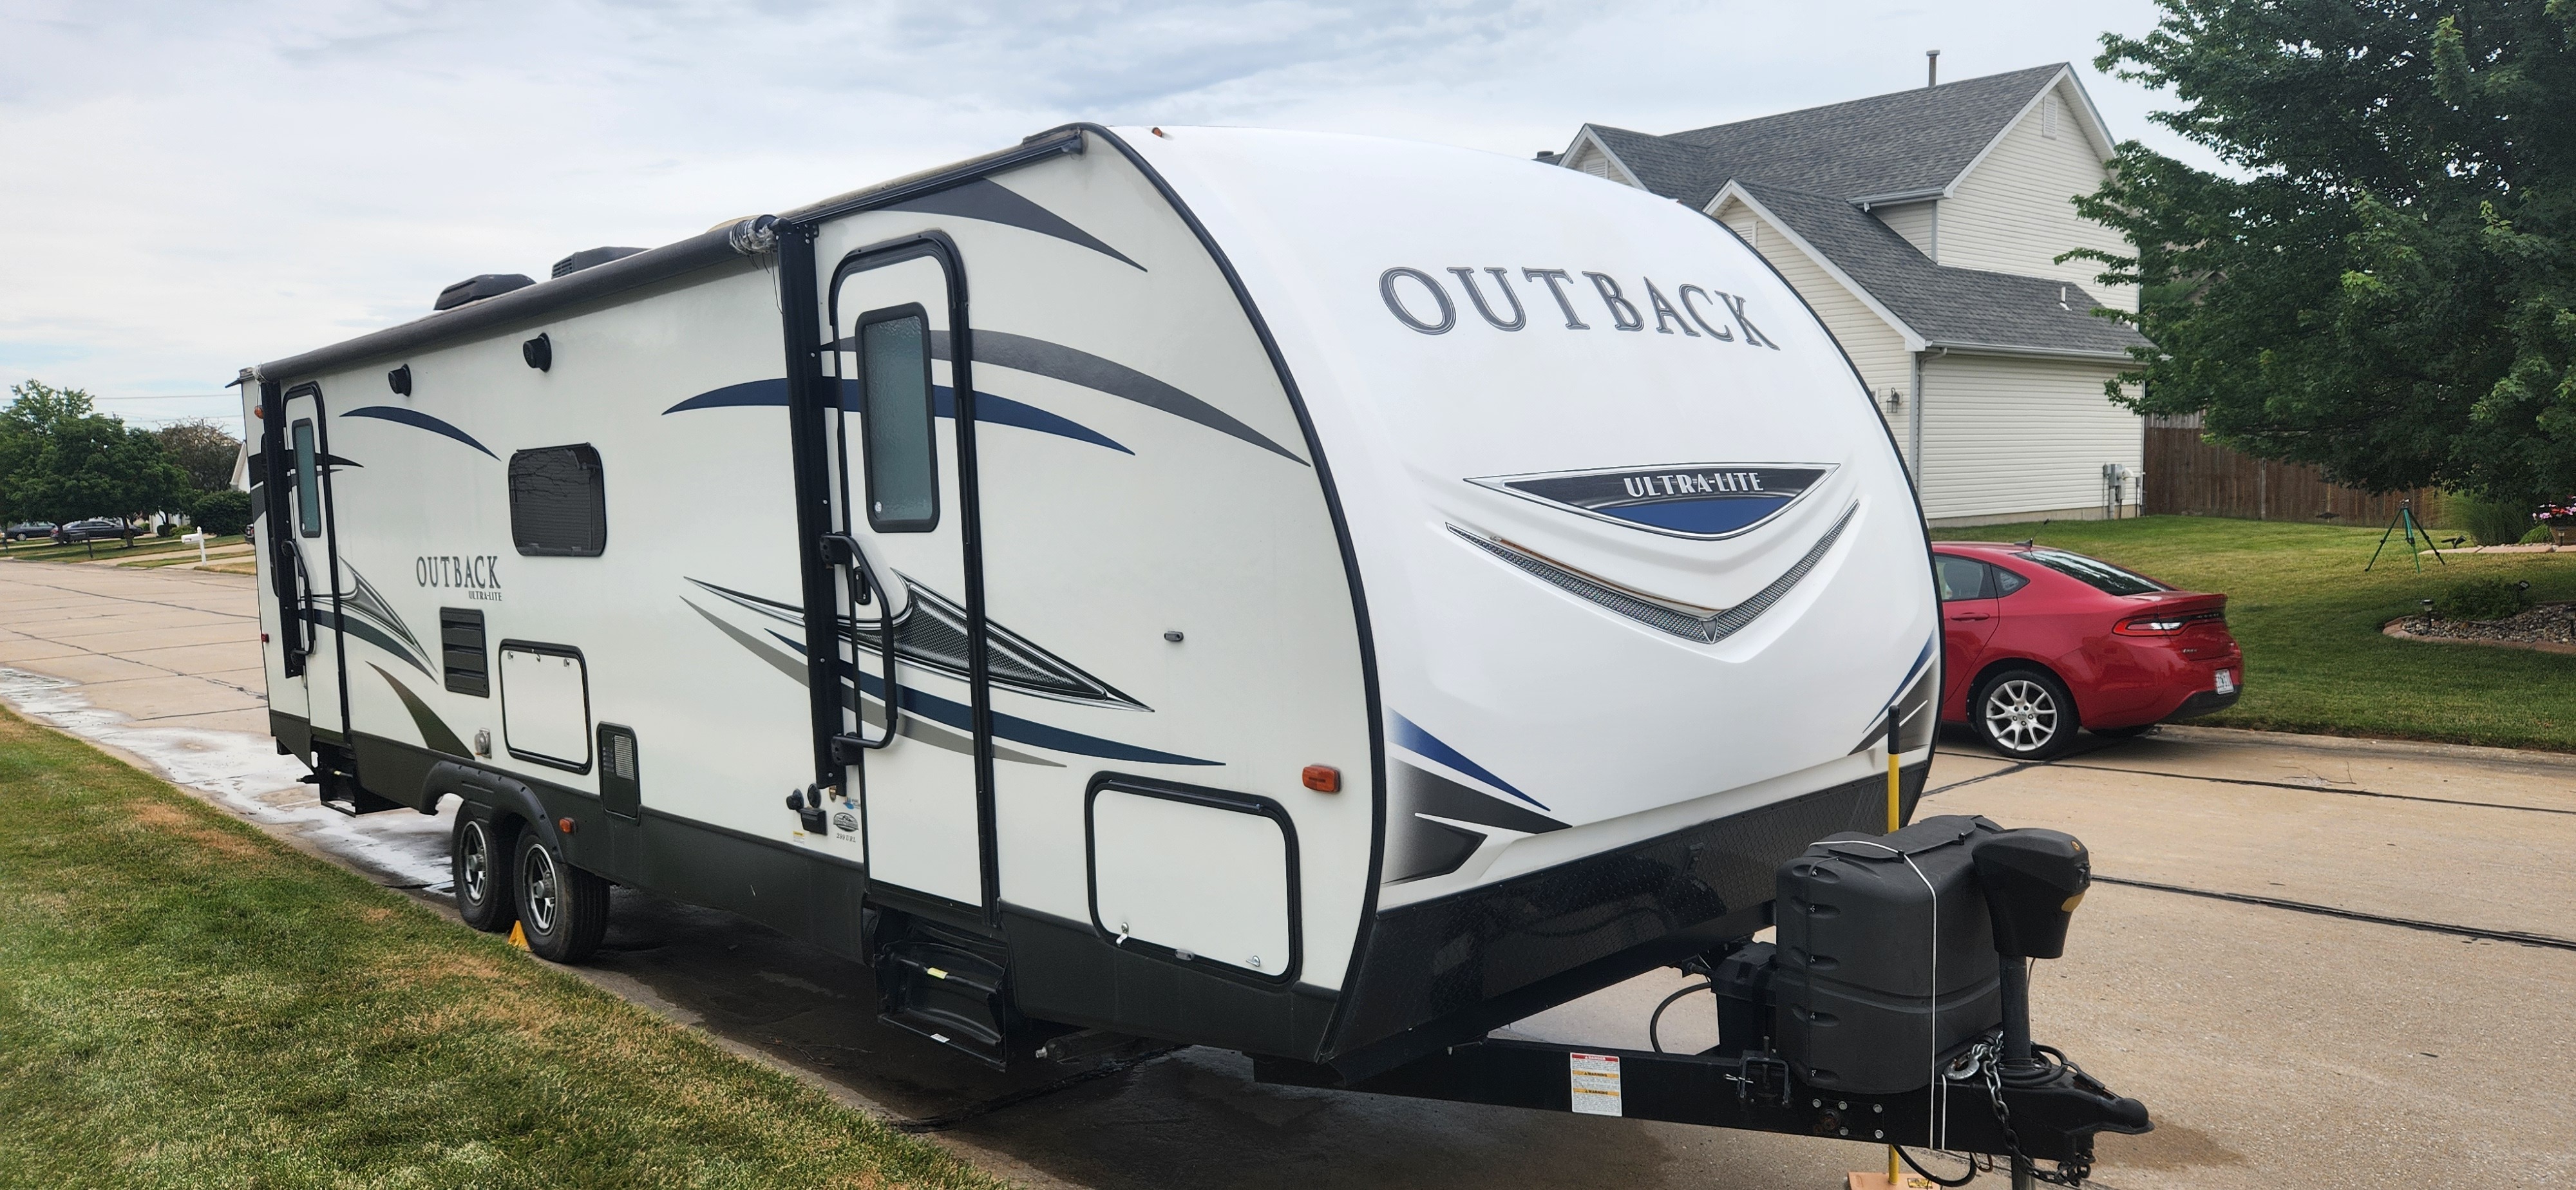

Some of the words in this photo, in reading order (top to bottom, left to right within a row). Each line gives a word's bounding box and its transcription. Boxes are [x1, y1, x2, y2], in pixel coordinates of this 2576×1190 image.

[1379, 267, 1781, 351] OUTBACK
[1624, 472, 1764, 498] ULTRA-LITE
[416, 555, 501, 589] OUTBACK
[468, 590, 502, 601] ULTRA-LITE
